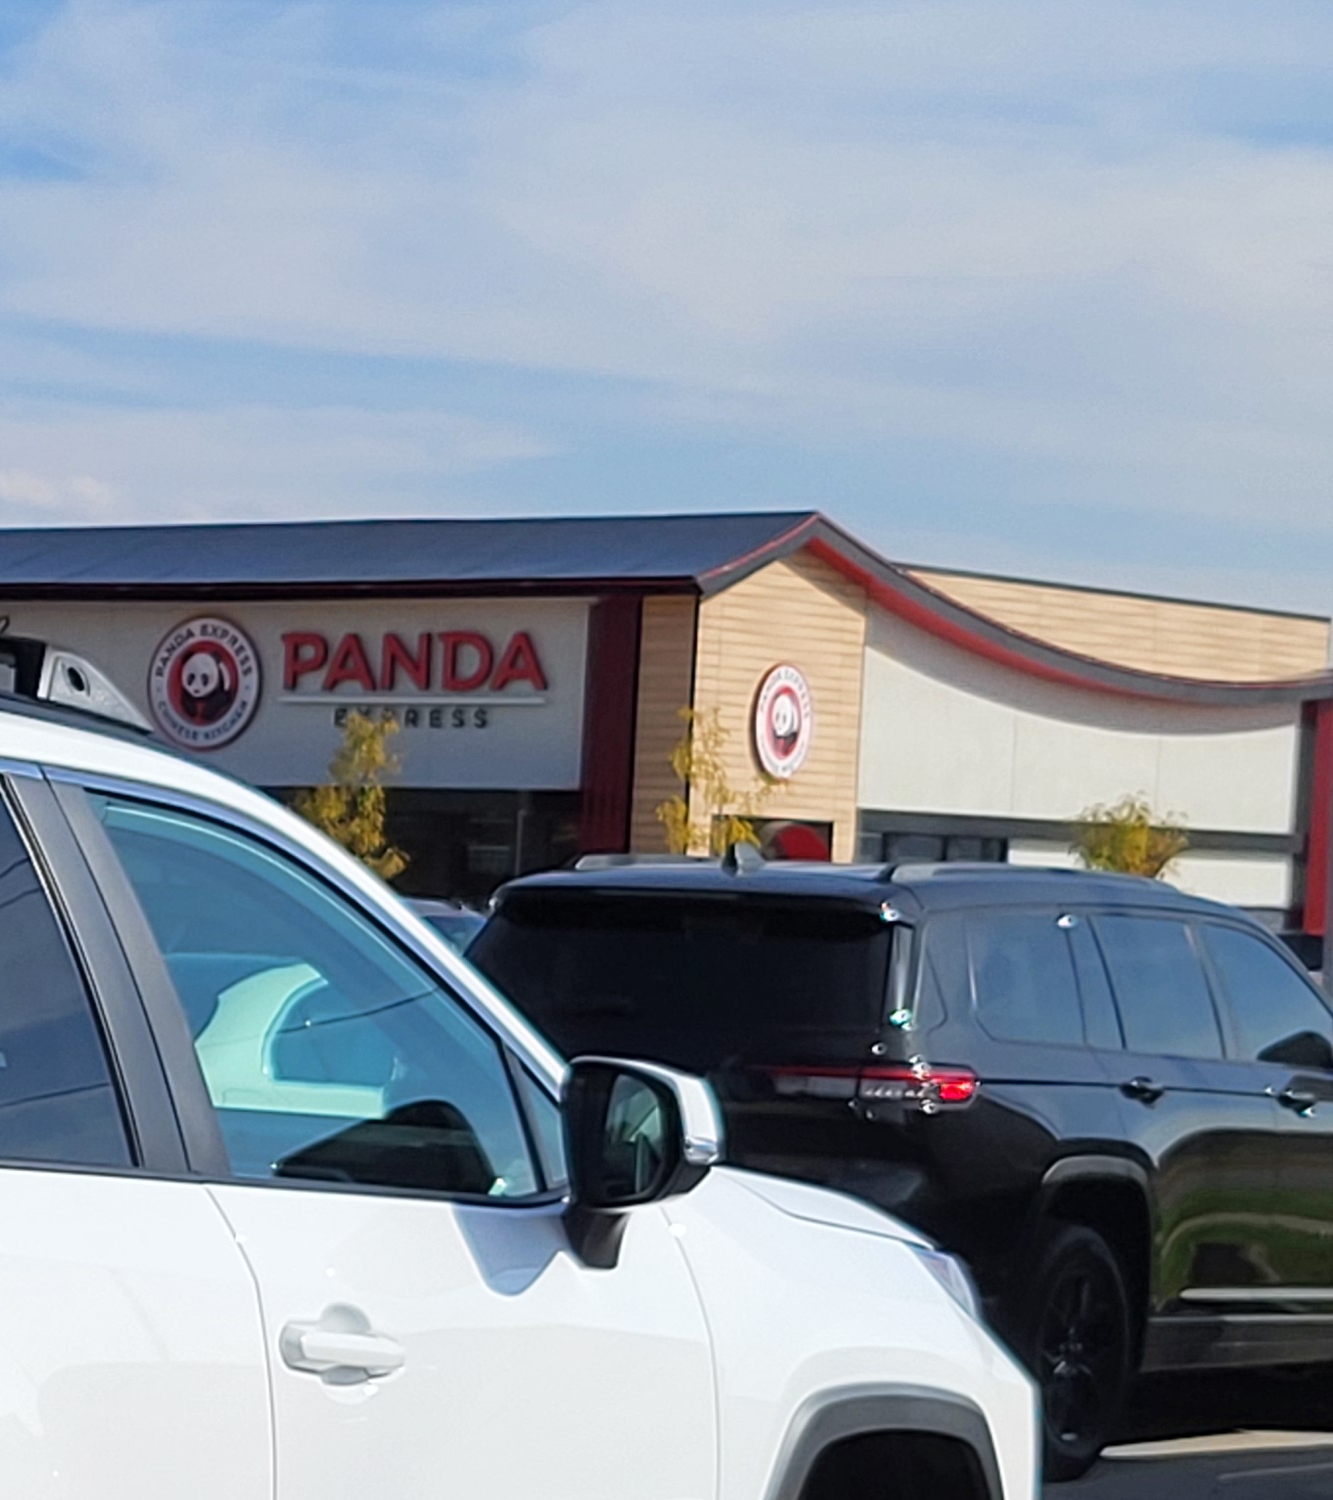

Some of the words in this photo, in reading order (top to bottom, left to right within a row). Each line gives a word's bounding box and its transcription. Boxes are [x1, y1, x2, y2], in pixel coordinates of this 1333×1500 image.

[155, 627, 195, 678] PANDA
[199, 623, 253, 677] EXPRESS
[281, 631, 548, 691] PANDA
